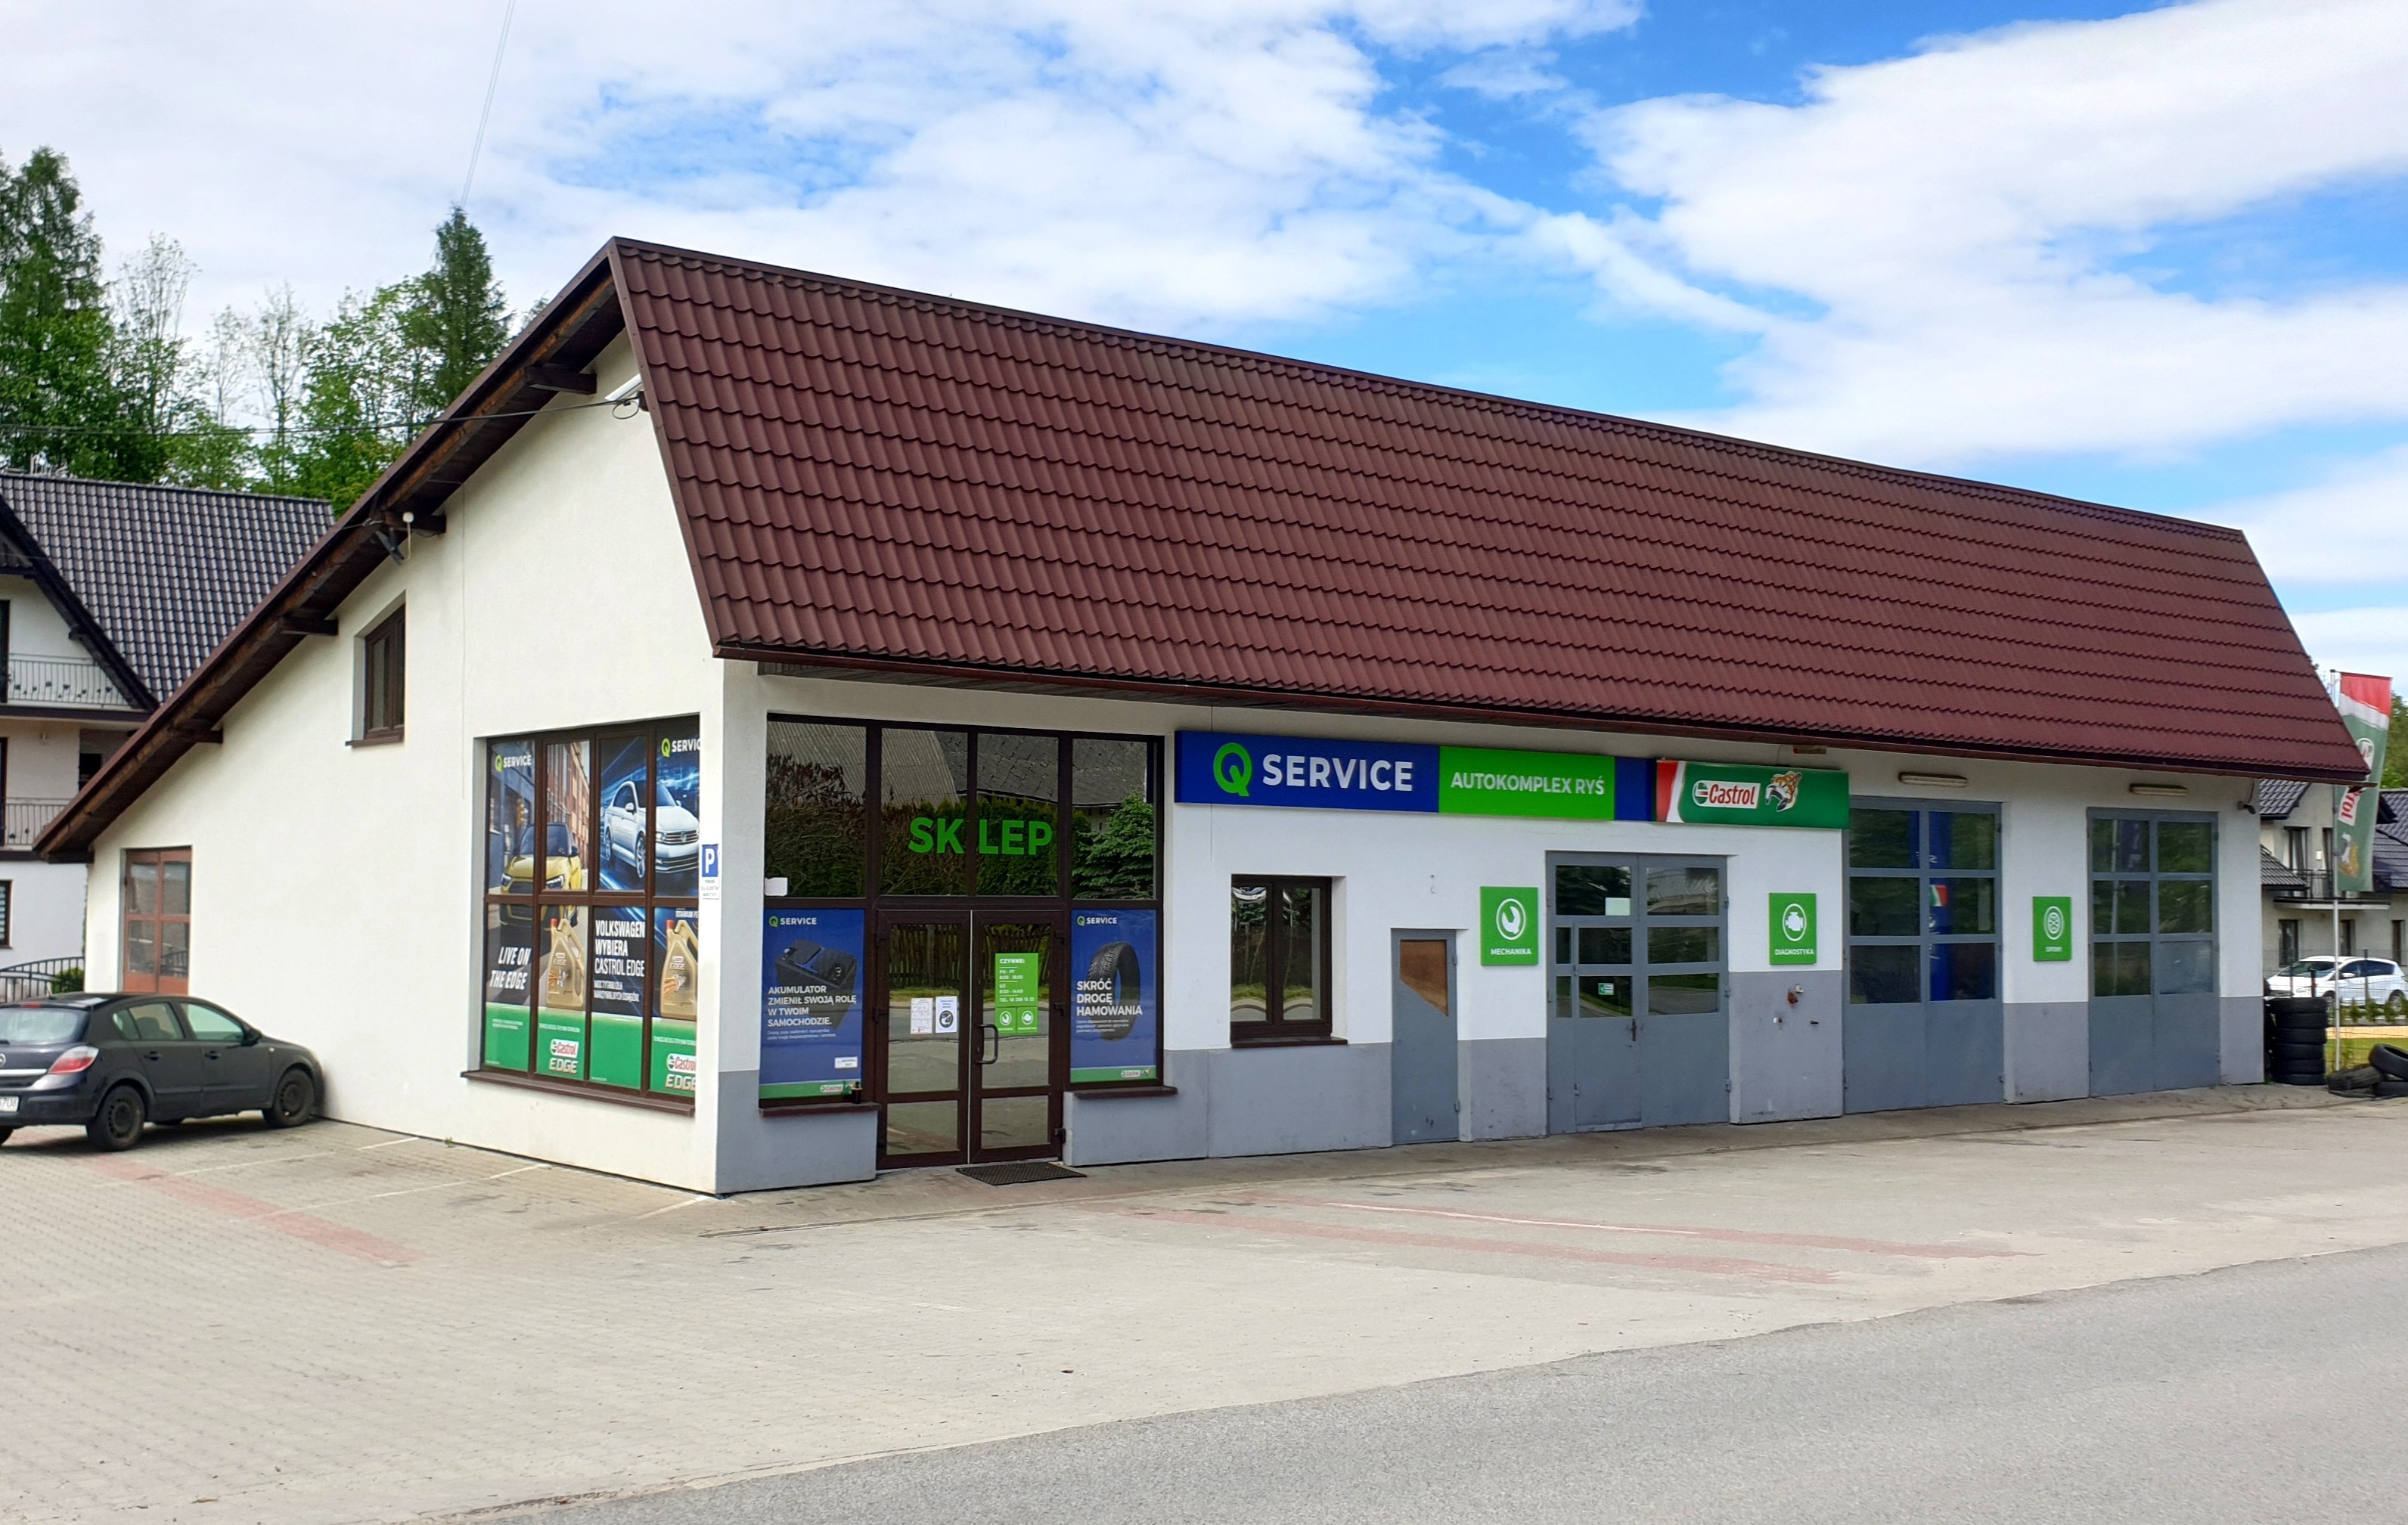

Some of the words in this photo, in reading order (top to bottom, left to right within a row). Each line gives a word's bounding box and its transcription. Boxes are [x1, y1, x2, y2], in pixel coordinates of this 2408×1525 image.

[503, 754, 532, 768] SERVICE
[1262, 754, 1413, 792] SERVICE
[1451, 772, 1572, 795] AUTOKOMPLEX
[1576, 775, 1606, 795] RYŚ
[1709, 783, 1755, 806] Castrol
[705, 848, 715, 874] P
[780, 917, 817, 925] SERVICE
[595, 920, 646, 938] VOLKSWAGEN
[595, 938, 628, 956] WYBIERA
[498, 947, 518, 966] LIVE
[517, 947, 532, 966] ON
[594, 958, 625, 976] CASTROL
[626, 960, 645, 977] EDGE
[489, 970, 507, 988] THE
[504, 971, 529, 990] EDGE
[1076, 978, 1112, 990] SKRÓĆ
[768, 985, 827, 994] AKUMULATOR
[768, 997, 802, 1006] ZMIENIŁ
[804, 996, 834, 1006] SWOJĄ
[835, 995, 857, 1004] ROLĘ
[1076, 993, 1113, 1006] DROGĘ
[768, 1008, 777, 1016] W
[778, 1007, 809, 1015] TWOIM
[1076, 1006, 1143, 1016] HAMOWANIA
[767, 1017, 833, 1027] SAMOCHODZIE.
[550, 1059, 579, 1074] EDGE
